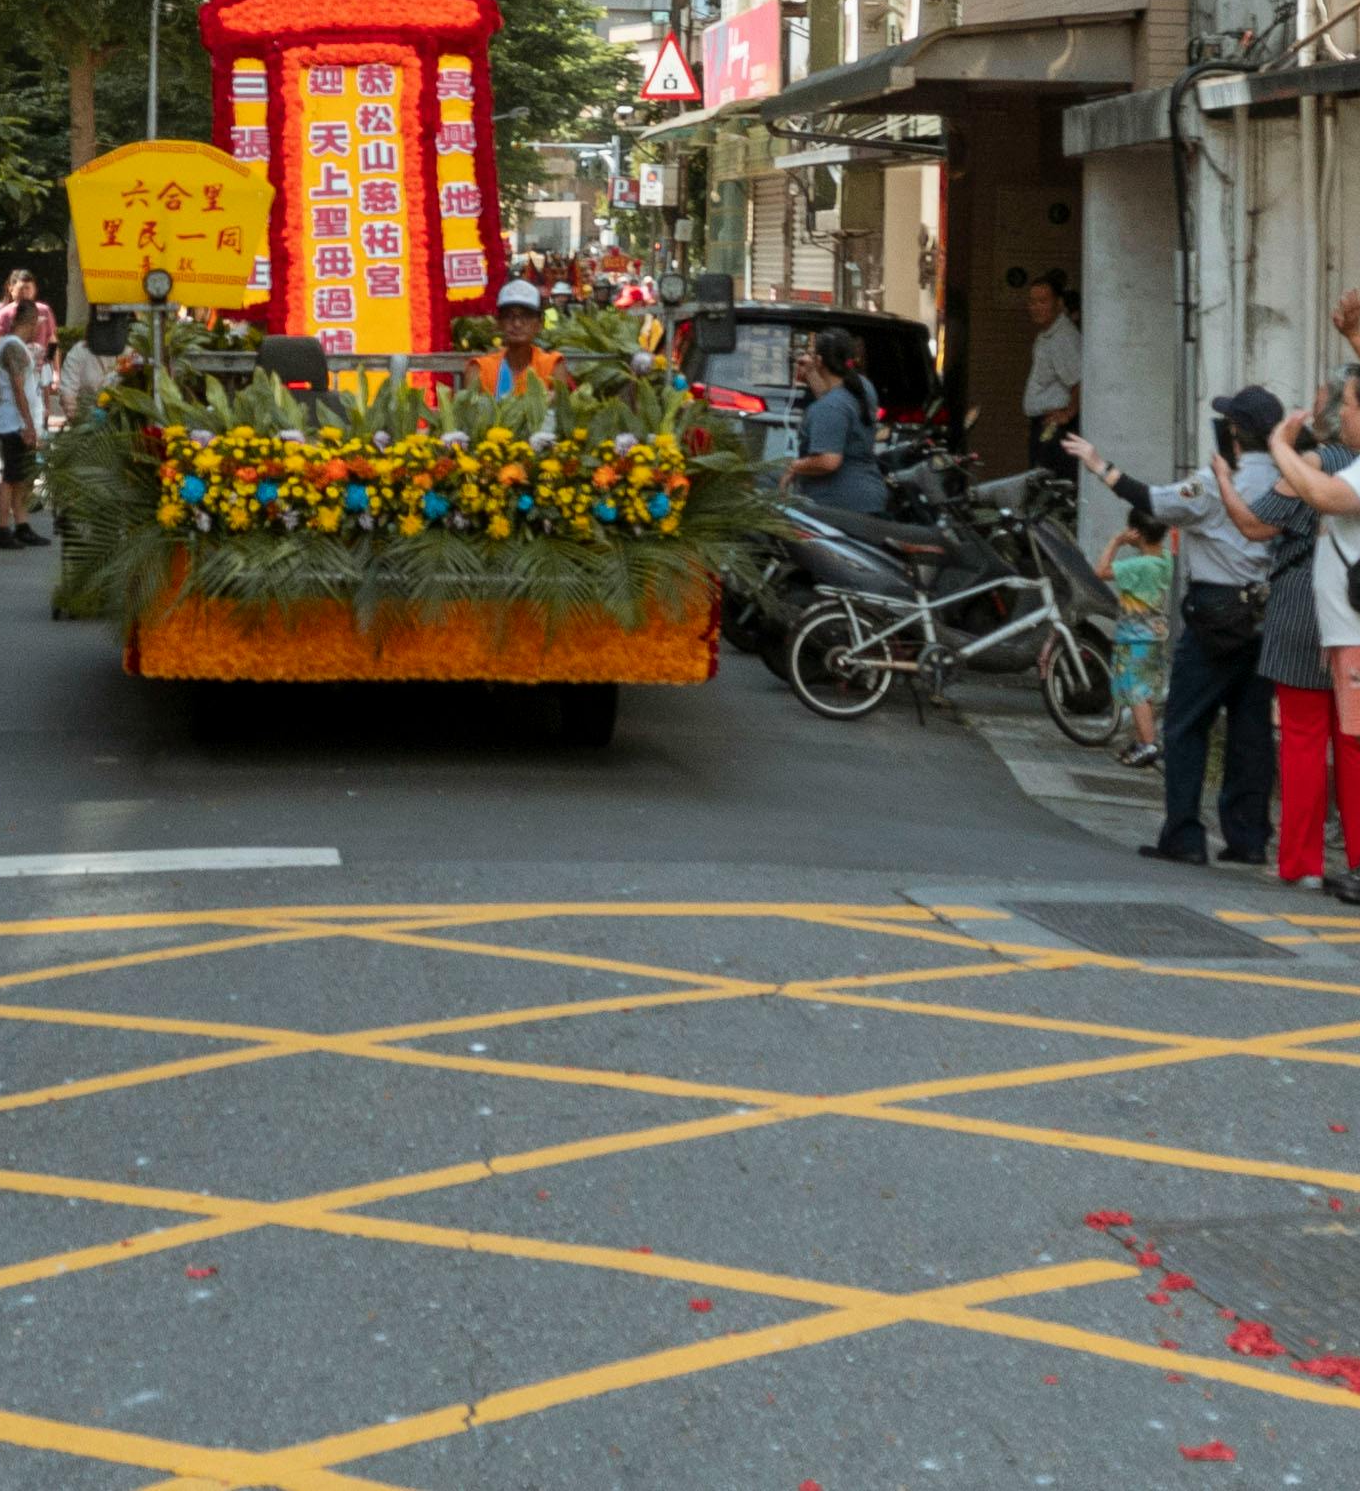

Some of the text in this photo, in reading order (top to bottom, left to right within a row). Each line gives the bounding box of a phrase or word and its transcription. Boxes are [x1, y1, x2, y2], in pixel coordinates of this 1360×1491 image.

[121, 179, 225, 212] 六合里
[437, 68, 488, 287] 吳興地區
[99, 218, 243, 255] 里民一同
